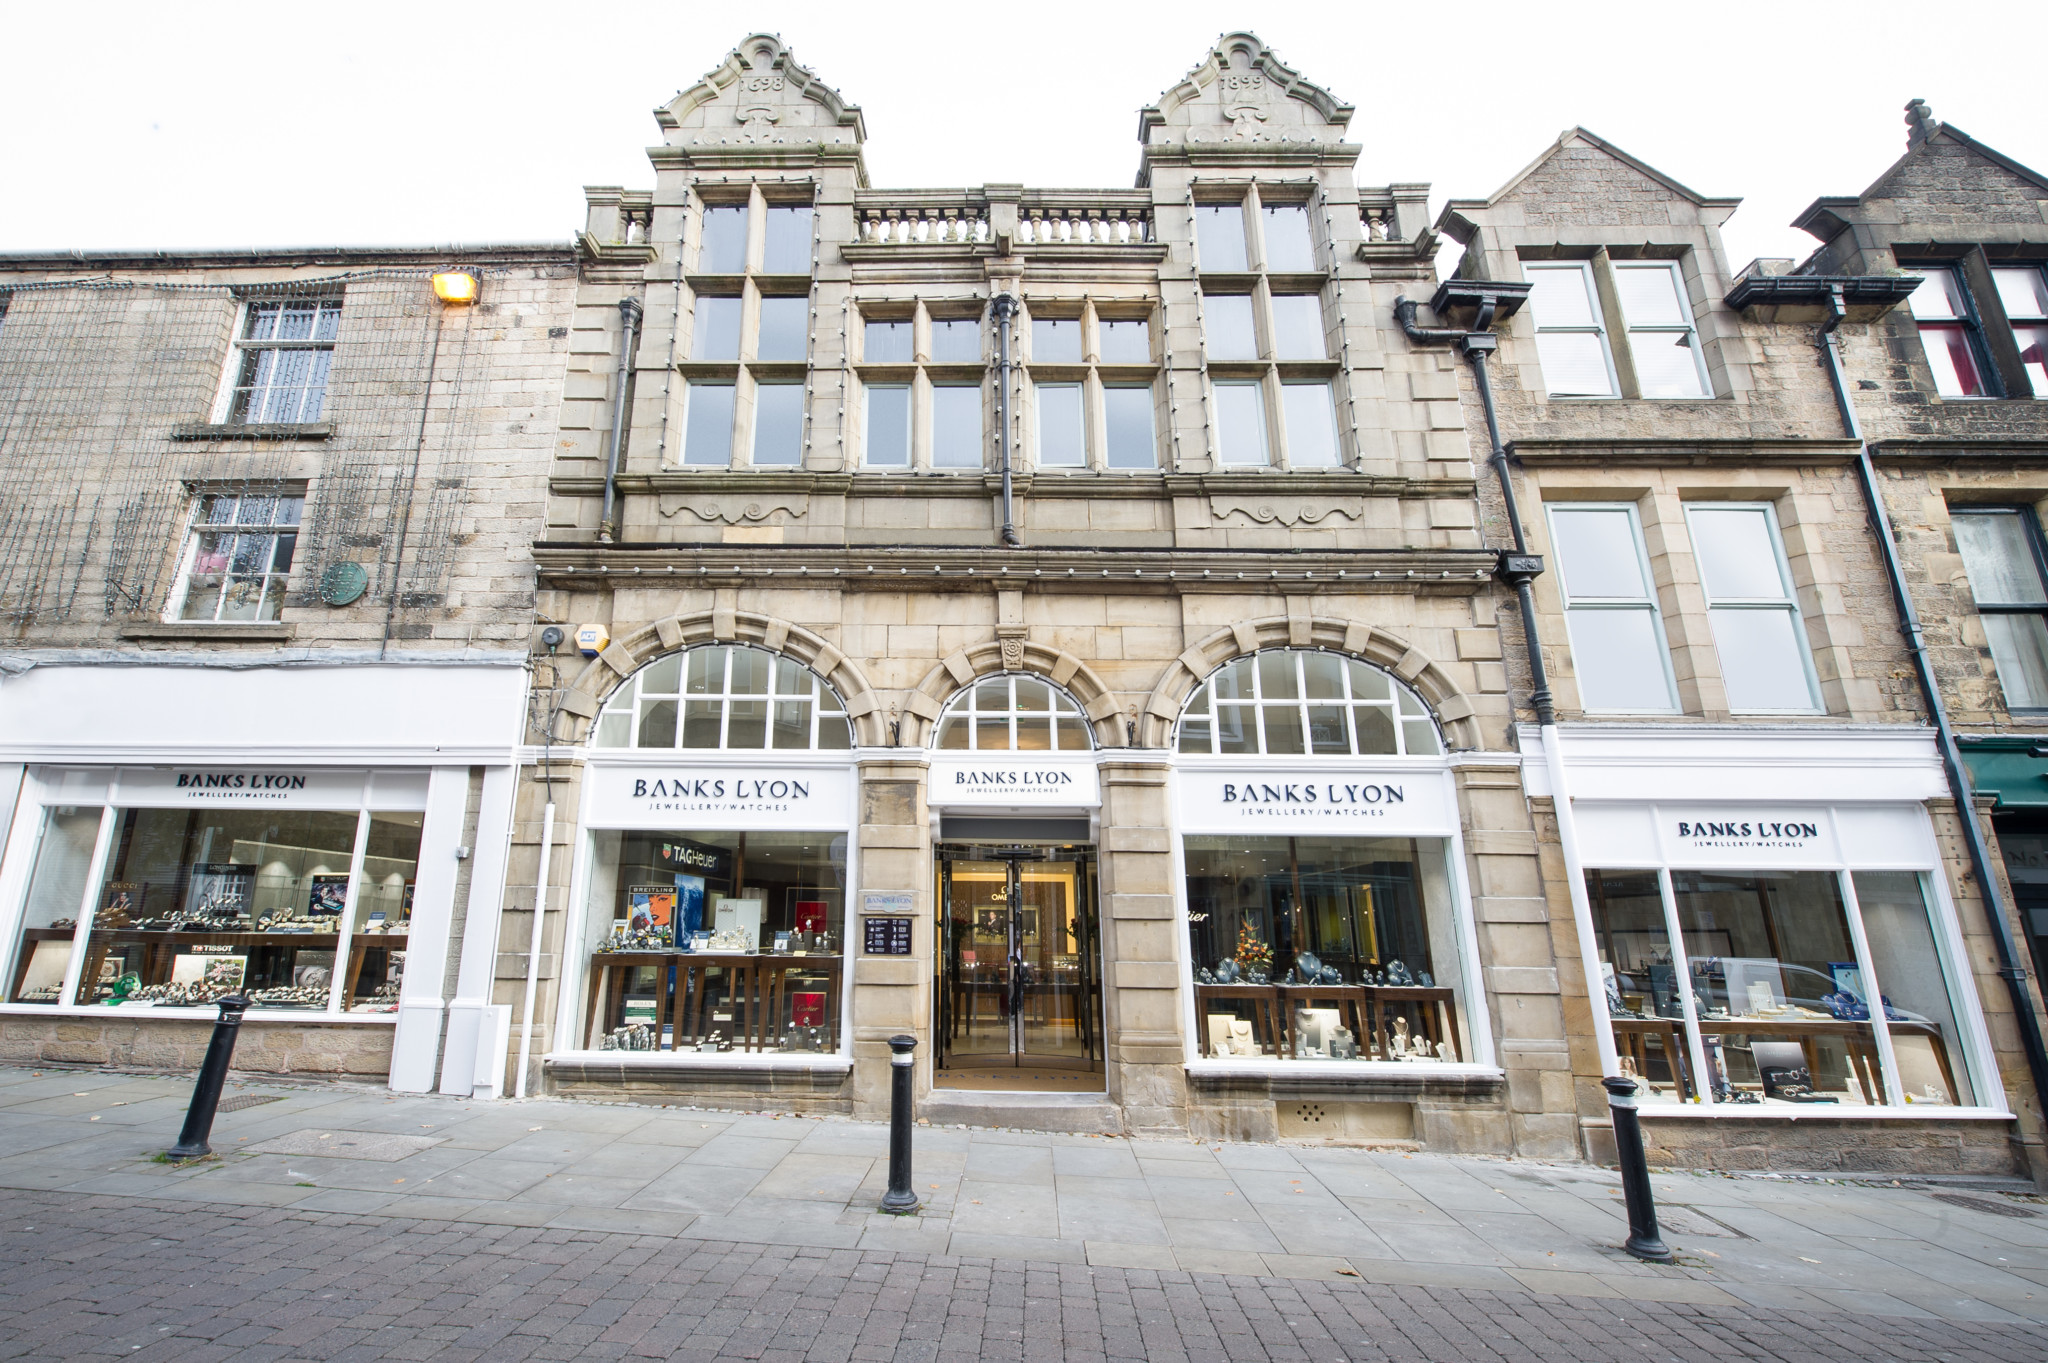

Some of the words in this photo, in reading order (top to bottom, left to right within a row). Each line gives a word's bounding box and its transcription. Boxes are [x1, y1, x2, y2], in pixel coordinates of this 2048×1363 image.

[581, 631, 596, 641] ADT
[177, 773, 245, 788] BANKS
[250, 775, 306, 789] LYON
[954, 771, 1017, 784] BANKS
[1024, 771, 1072, 784] LYON
[633, 779, 725, 798] BANKS
[737, 780, 809, 799] LYON
[1223, 784, 1318, 803] BANKS
[1328, 784, 1404, 803] LYON
[650, 803, 788, 811] JEWELLERY/WATCHES
[1242, 808, 1384, 816] JEWELLERY/WATCHES
[1678, 822, 1753, 837] BANKS
[1758, 823, 1818, 838] LYON
[991, 893, 1008, 901] OME
[204, 944, 234, 952] TISSOT
